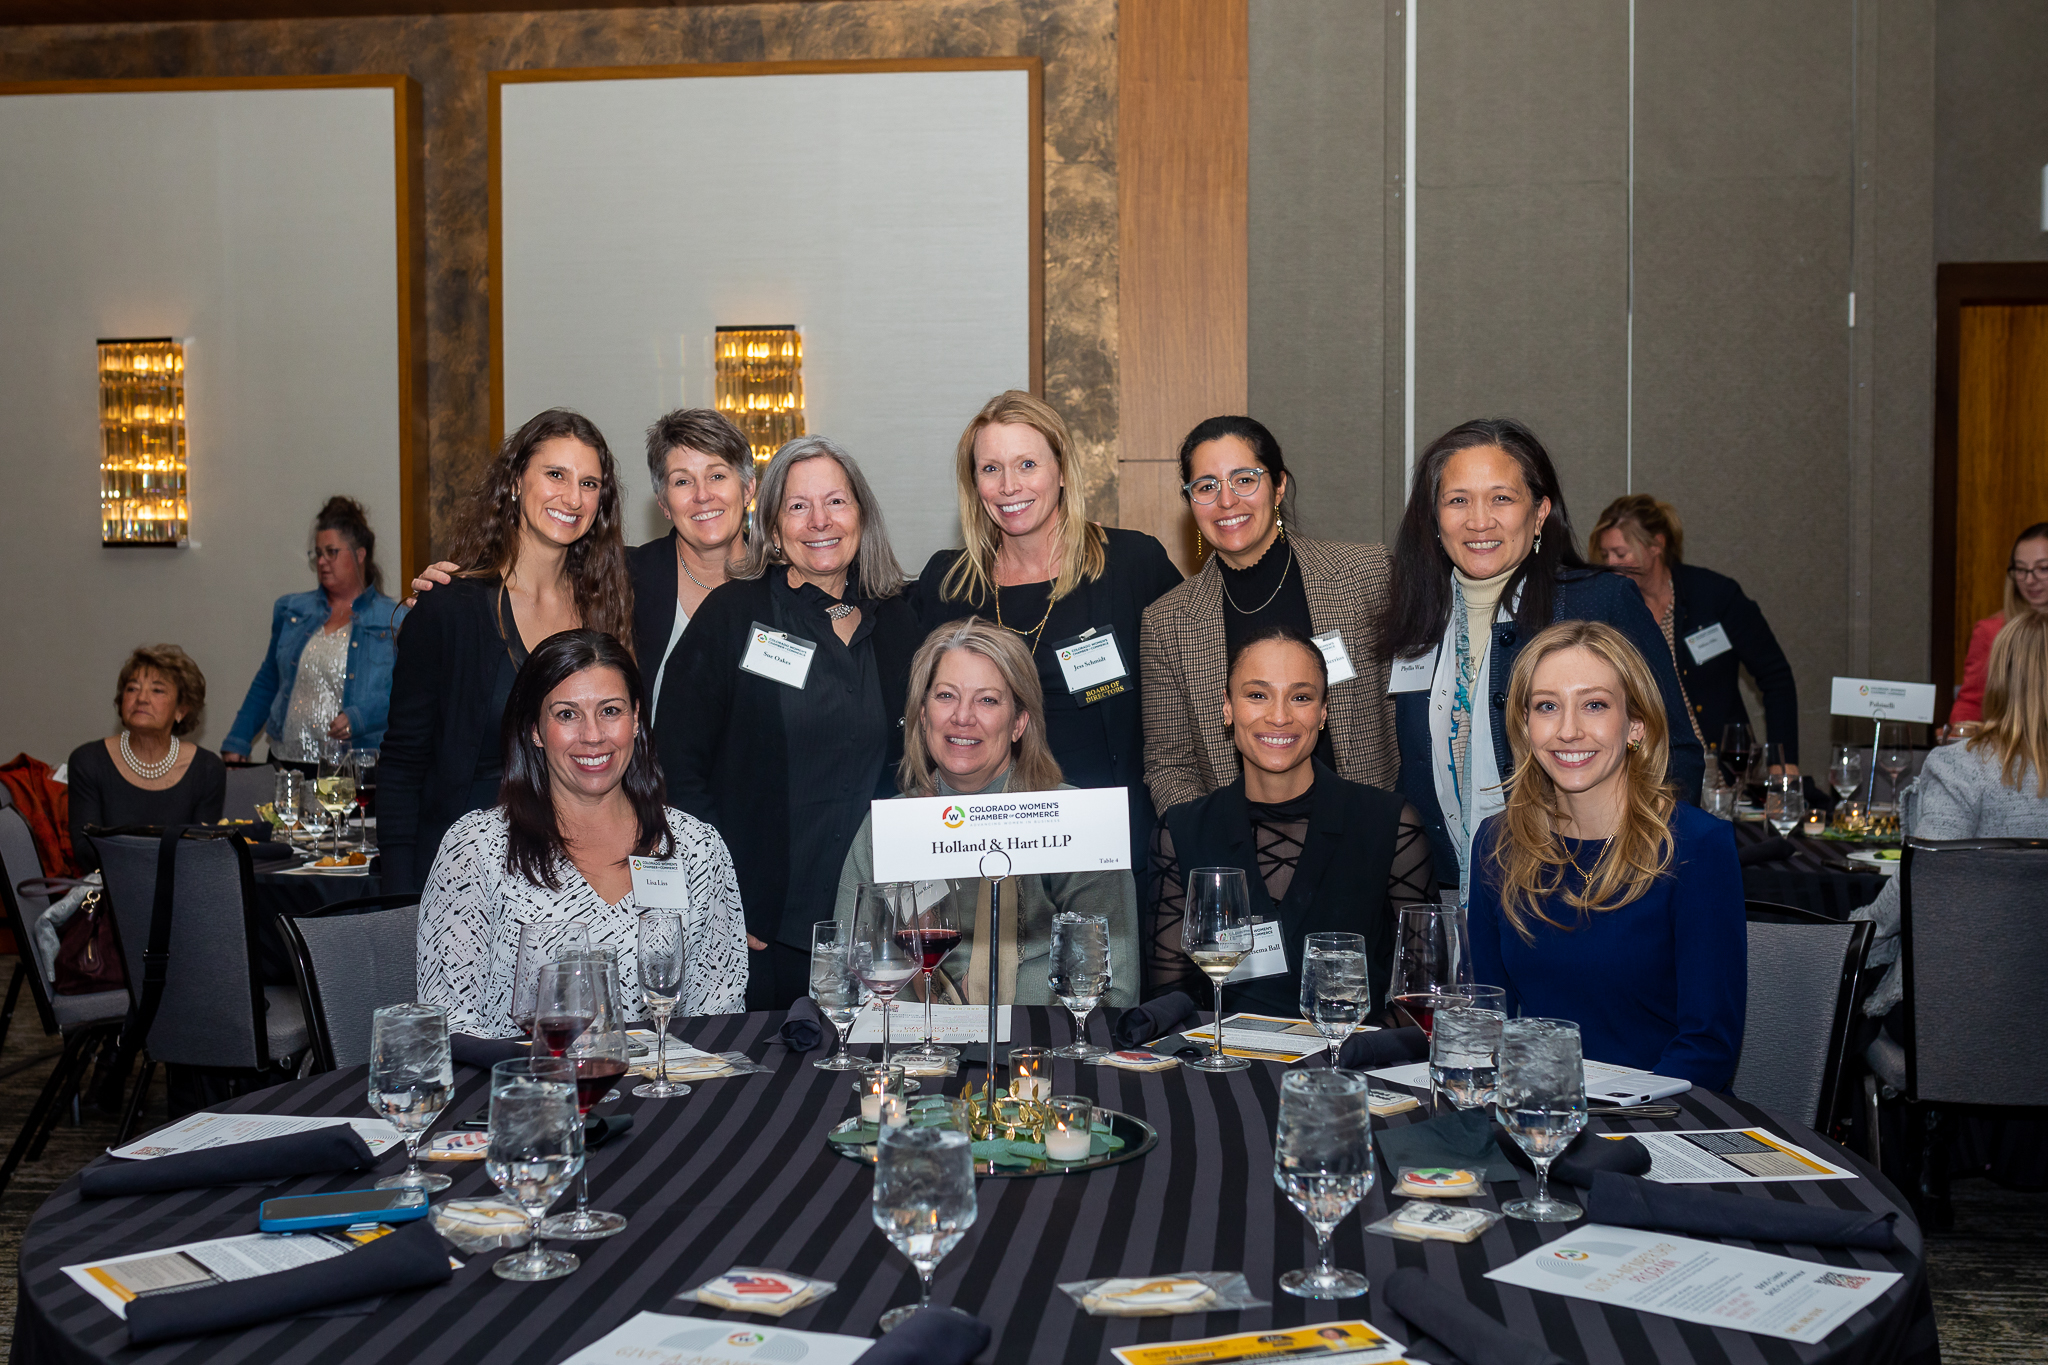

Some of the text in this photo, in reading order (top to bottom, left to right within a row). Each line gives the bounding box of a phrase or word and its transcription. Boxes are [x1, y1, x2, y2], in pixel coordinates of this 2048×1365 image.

[1085, 680, 1120, 697] BOARD OF
[1085, 685, 1125, 704] DIRECTORS
[969, 802, 1059, 813] COLORADO WOMEN'S
[969, 813, 1009, 821] CHAMBER
[1015, 811, 1060, 819] COMMERCE
[931, 834, 1072, 854] Holland & Hart LLP
[1268, 943, 1281, 952] Ball
